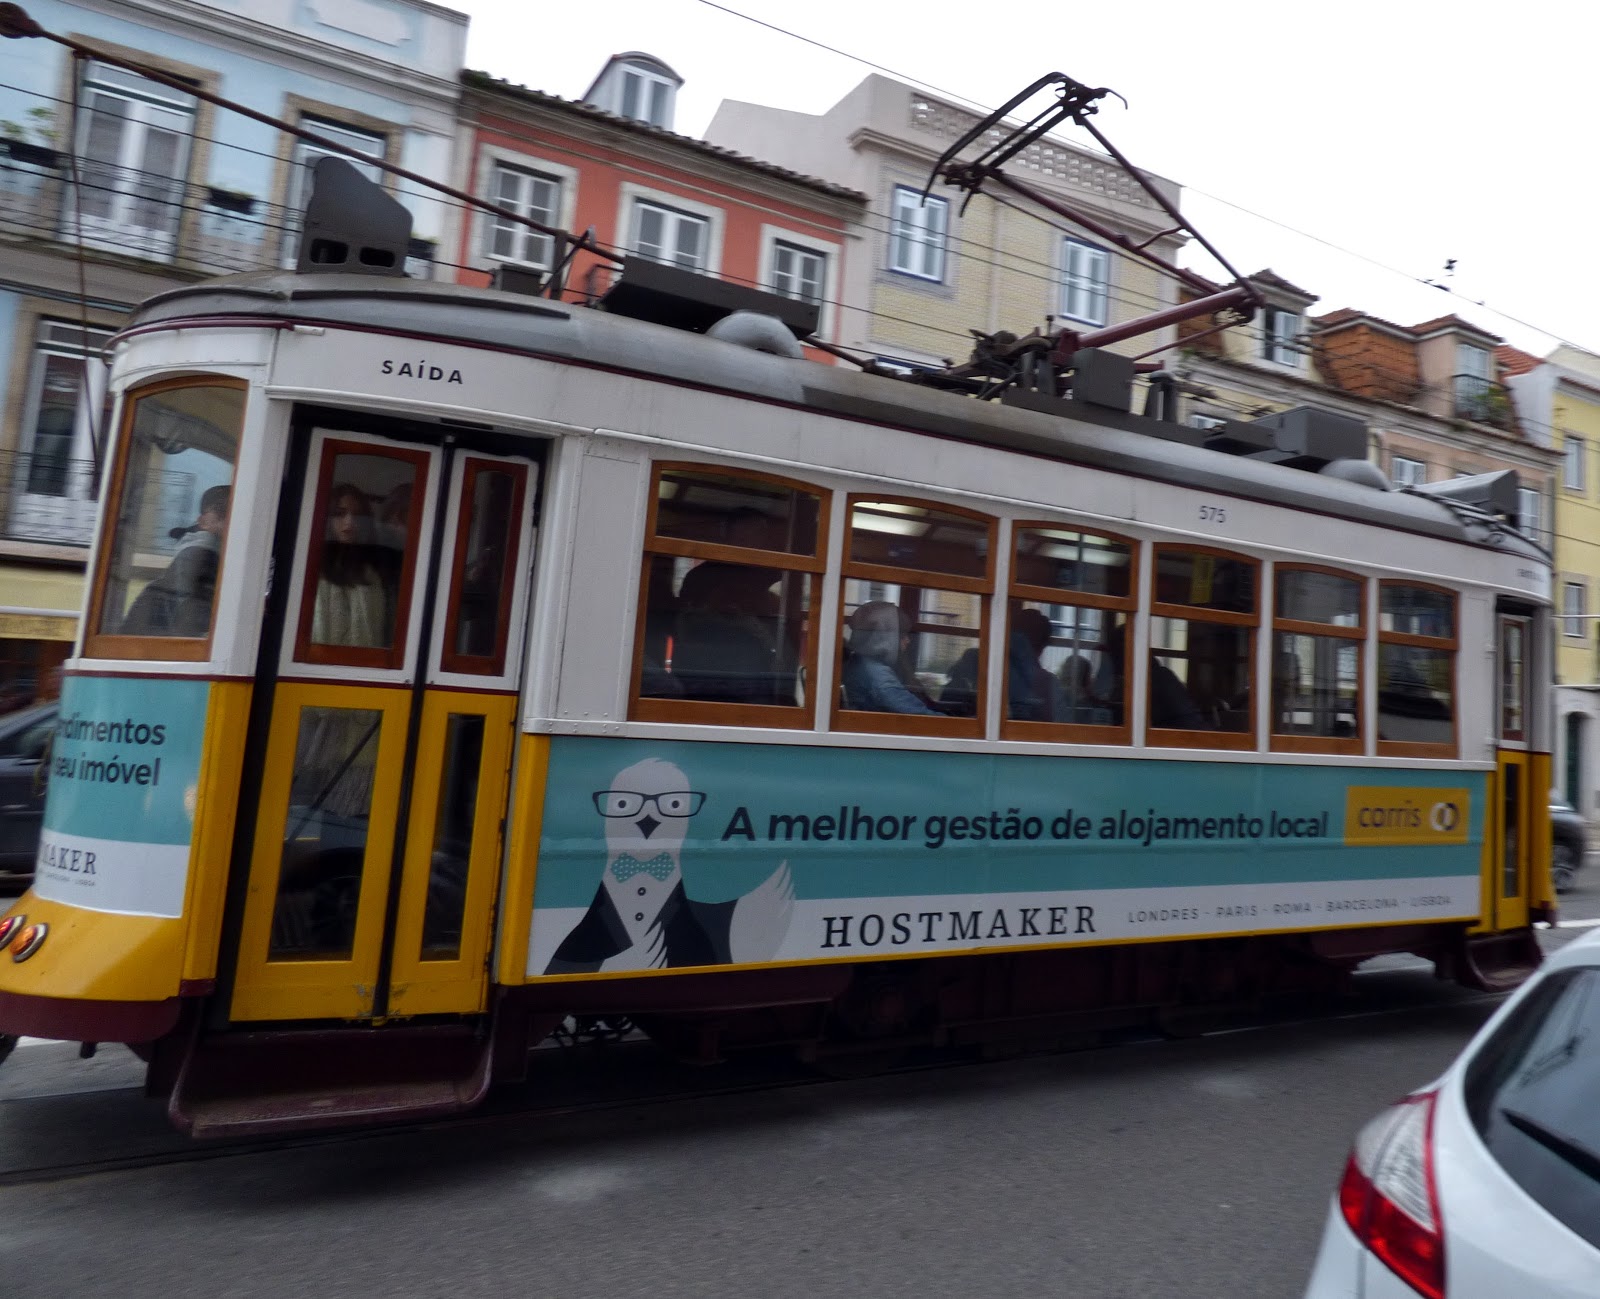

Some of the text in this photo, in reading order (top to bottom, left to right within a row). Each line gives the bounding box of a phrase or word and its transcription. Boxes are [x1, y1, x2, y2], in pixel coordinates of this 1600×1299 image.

[381, 359, 463, 385] SAÍDA
[1199, 505, 1226, 523] 575
[80, 752, 161, 786] imóvel
[720, 805, 1329, 849] A melhor gestão de alojamento local
[1127, 908, 1199, 923] LONDRES
[1216, 905, 1258, 917] PARIS
[1273, 902, 1312, 914] ROMA
[1326, 898, 1398, 912] BARCELONA
[820, 905, 1097, 948] HOSTMAKER
